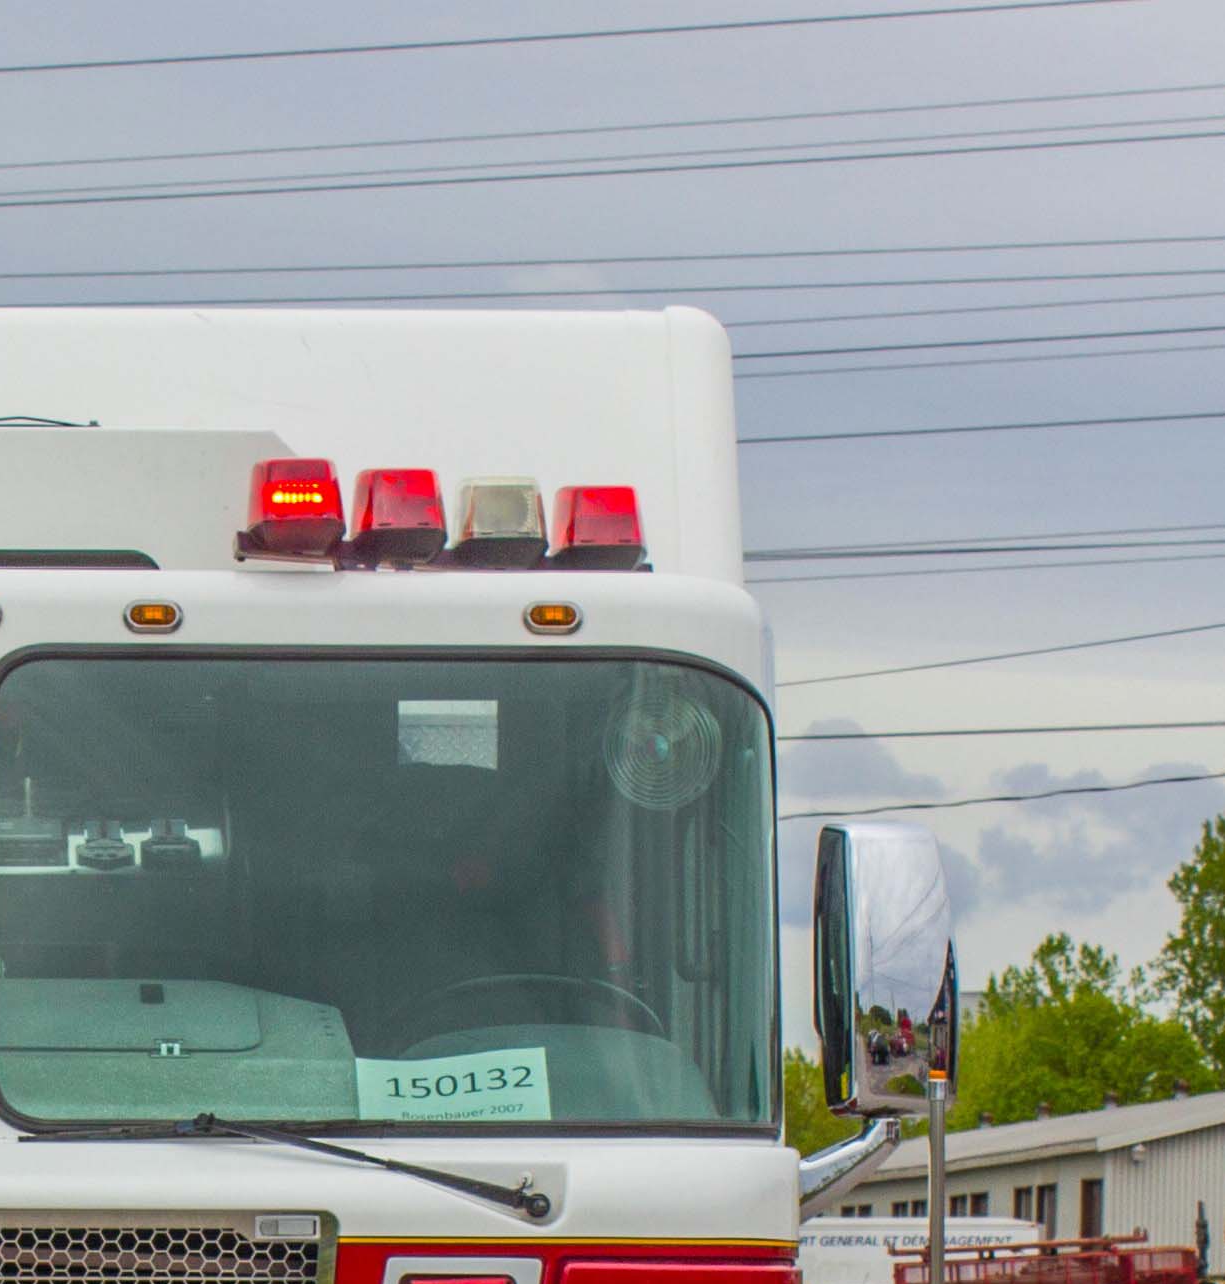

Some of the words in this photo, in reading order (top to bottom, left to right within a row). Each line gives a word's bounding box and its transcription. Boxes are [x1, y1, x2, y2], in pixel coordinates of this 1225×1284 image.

[386, 1066, 534, 1099] 150132
[402, 1108, 485, 1120] Rosenbauer
[490, 1104, 524, 1115] 2007
